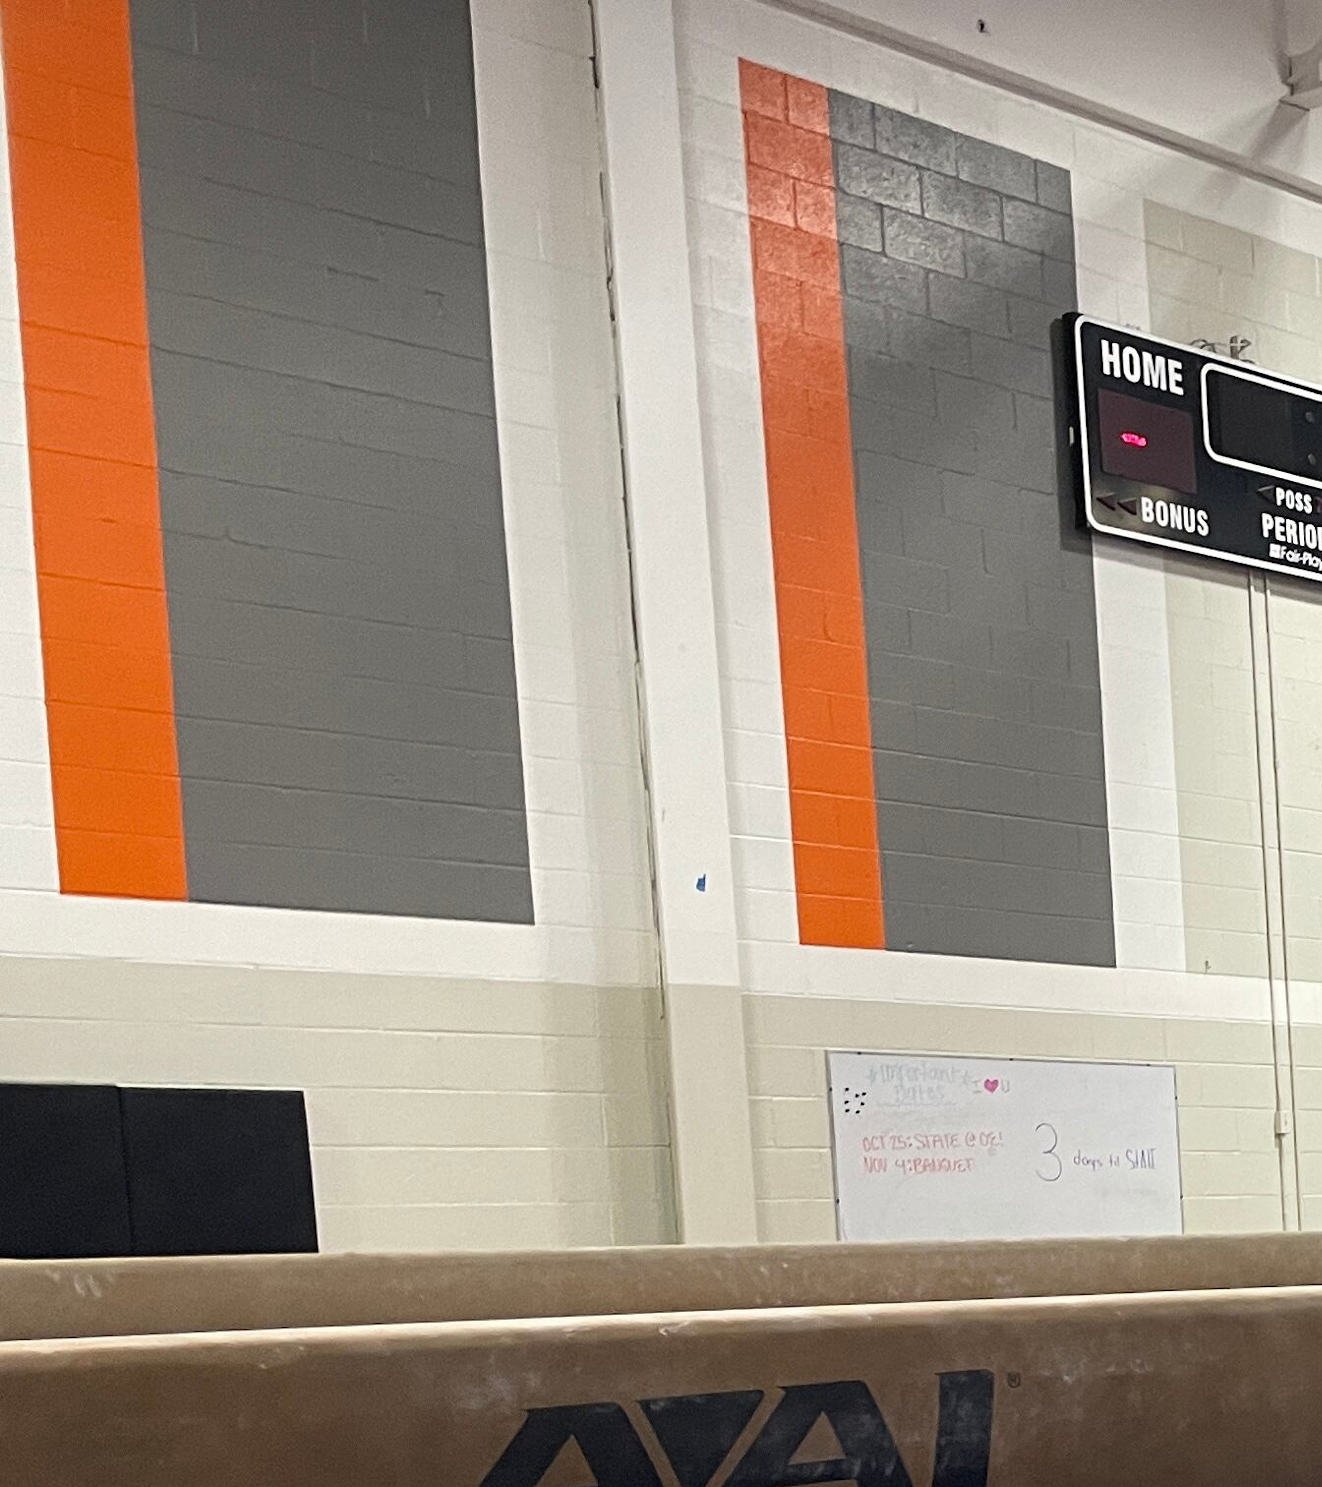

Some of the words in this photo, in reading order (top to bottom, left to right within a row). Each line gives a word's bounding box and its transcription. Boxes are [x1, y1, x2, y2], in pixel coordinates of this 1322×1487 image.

[1101, 339, 1185, 396] HOME
[1141, 497, 1210, 537] BONUS
[1276, 487, 1313, 514] POSS
[914, 1131, 962, 1150] STATE
[1035, 1122, 1063, 1182] 3
